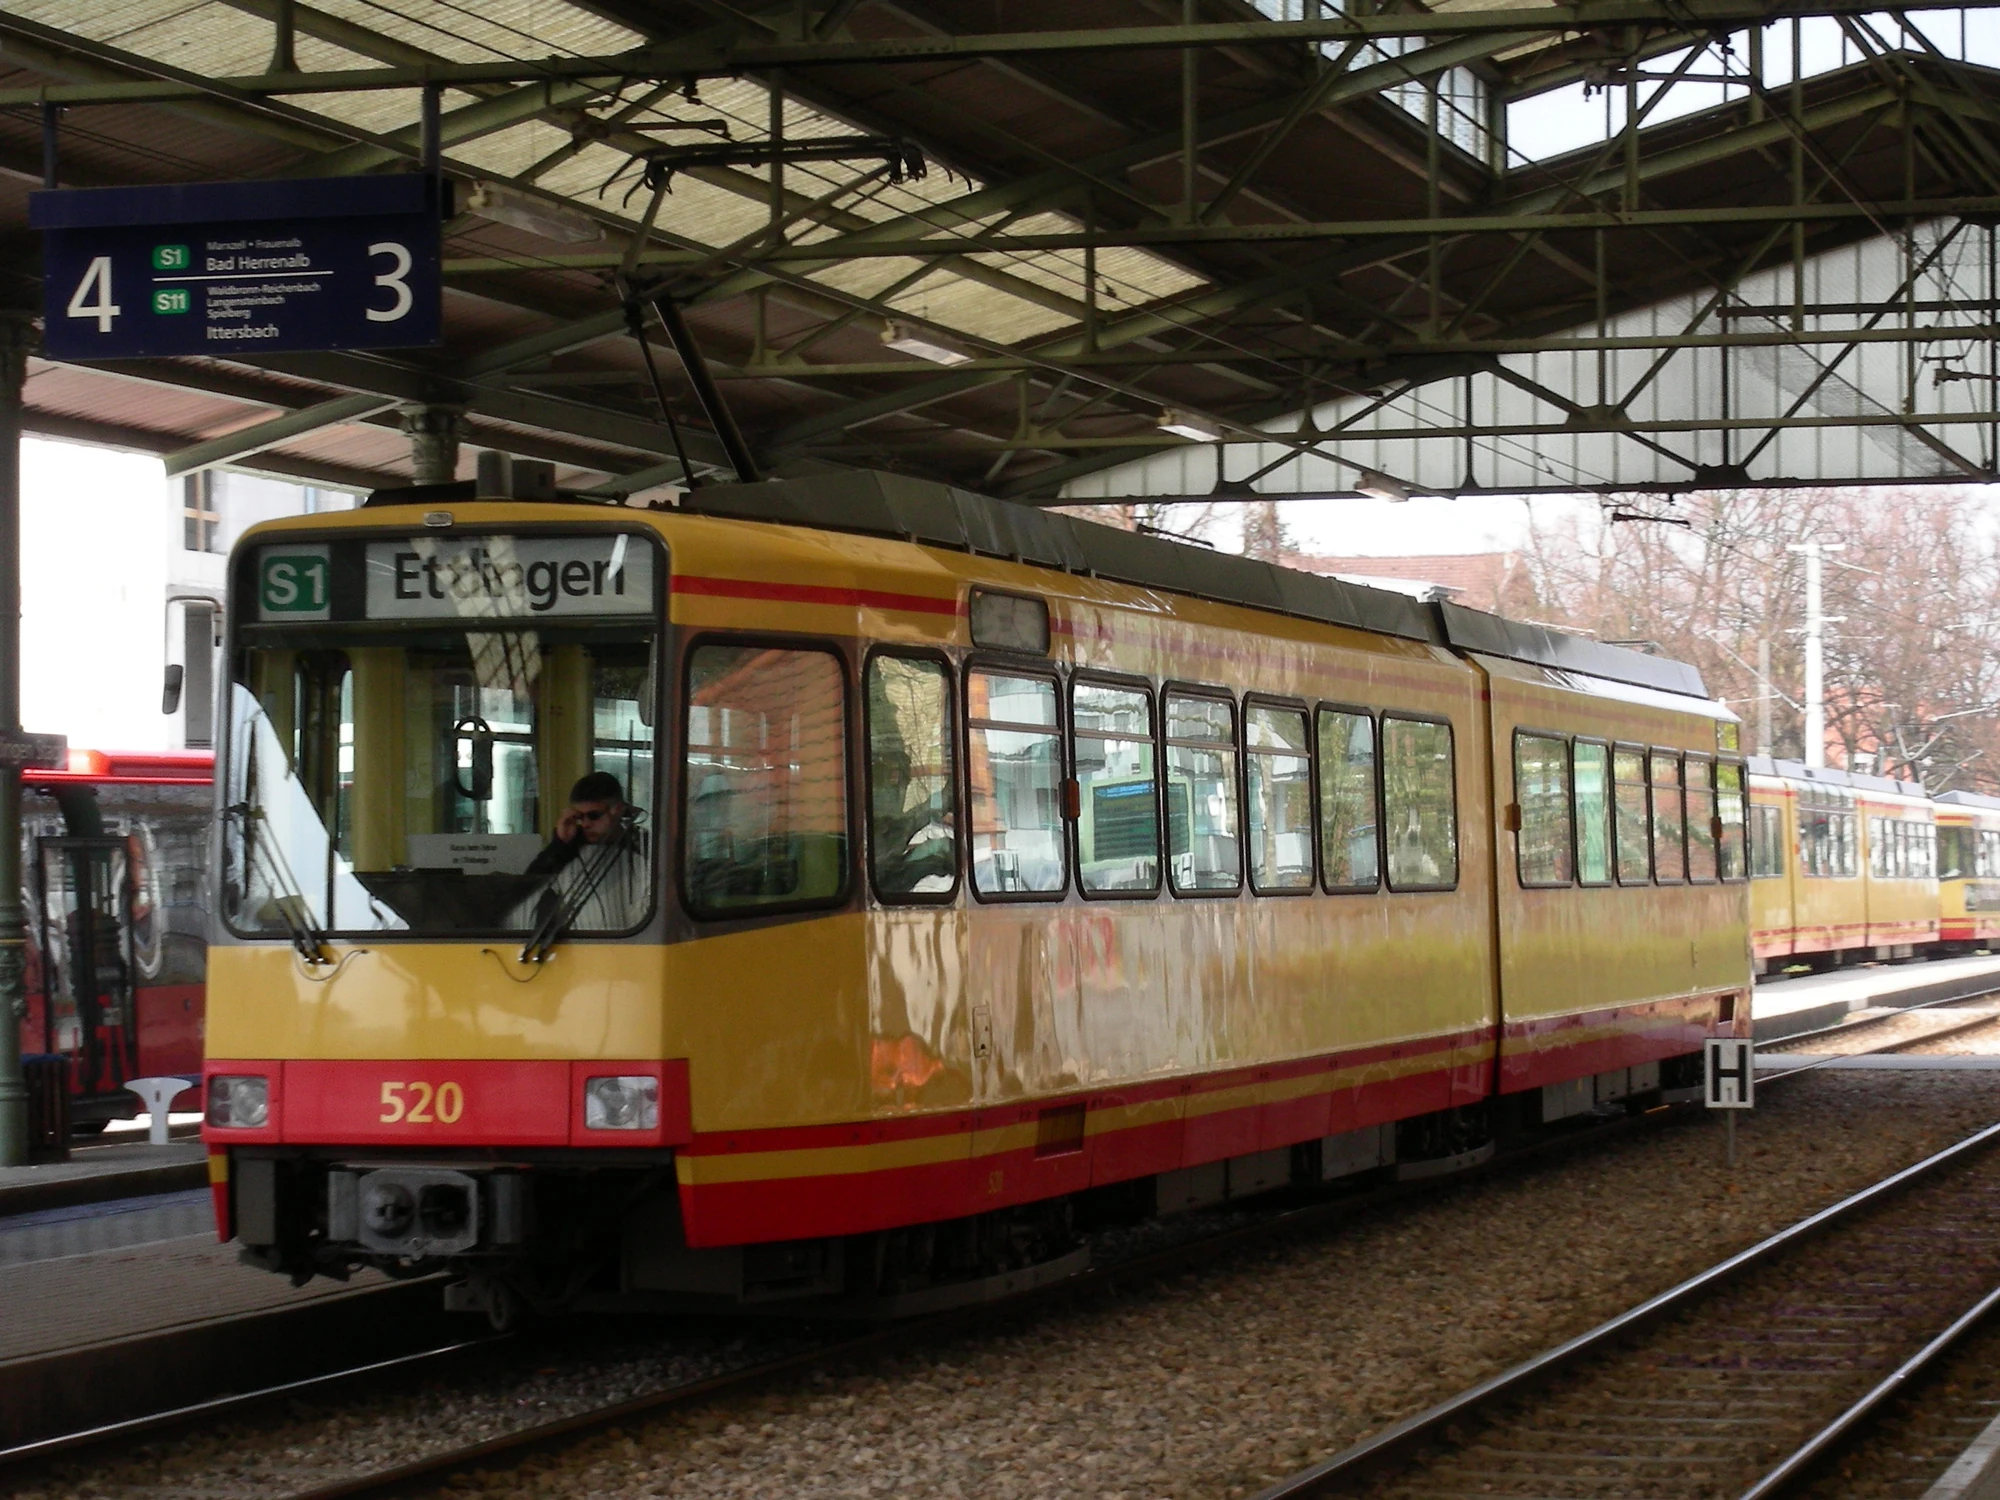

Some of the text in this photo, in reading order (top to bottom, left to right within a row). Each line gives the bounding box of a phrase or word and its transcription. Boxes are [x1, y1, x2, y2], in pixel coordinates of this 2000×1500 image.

[160, 249, 182, 266] S1
[206, 253, 311, 271] Bad Herrenalb
[67, 256, 121, 333] 4
[157, 293, 186, 310] S11
[366, 242, 413, 322] 3
[206, 323, 280, 339] Ittersbach
[265, 564, 325, 605] S1
[1711, 1044, 1747, 1102] H
[379, 1081, 464, 1124] 520
